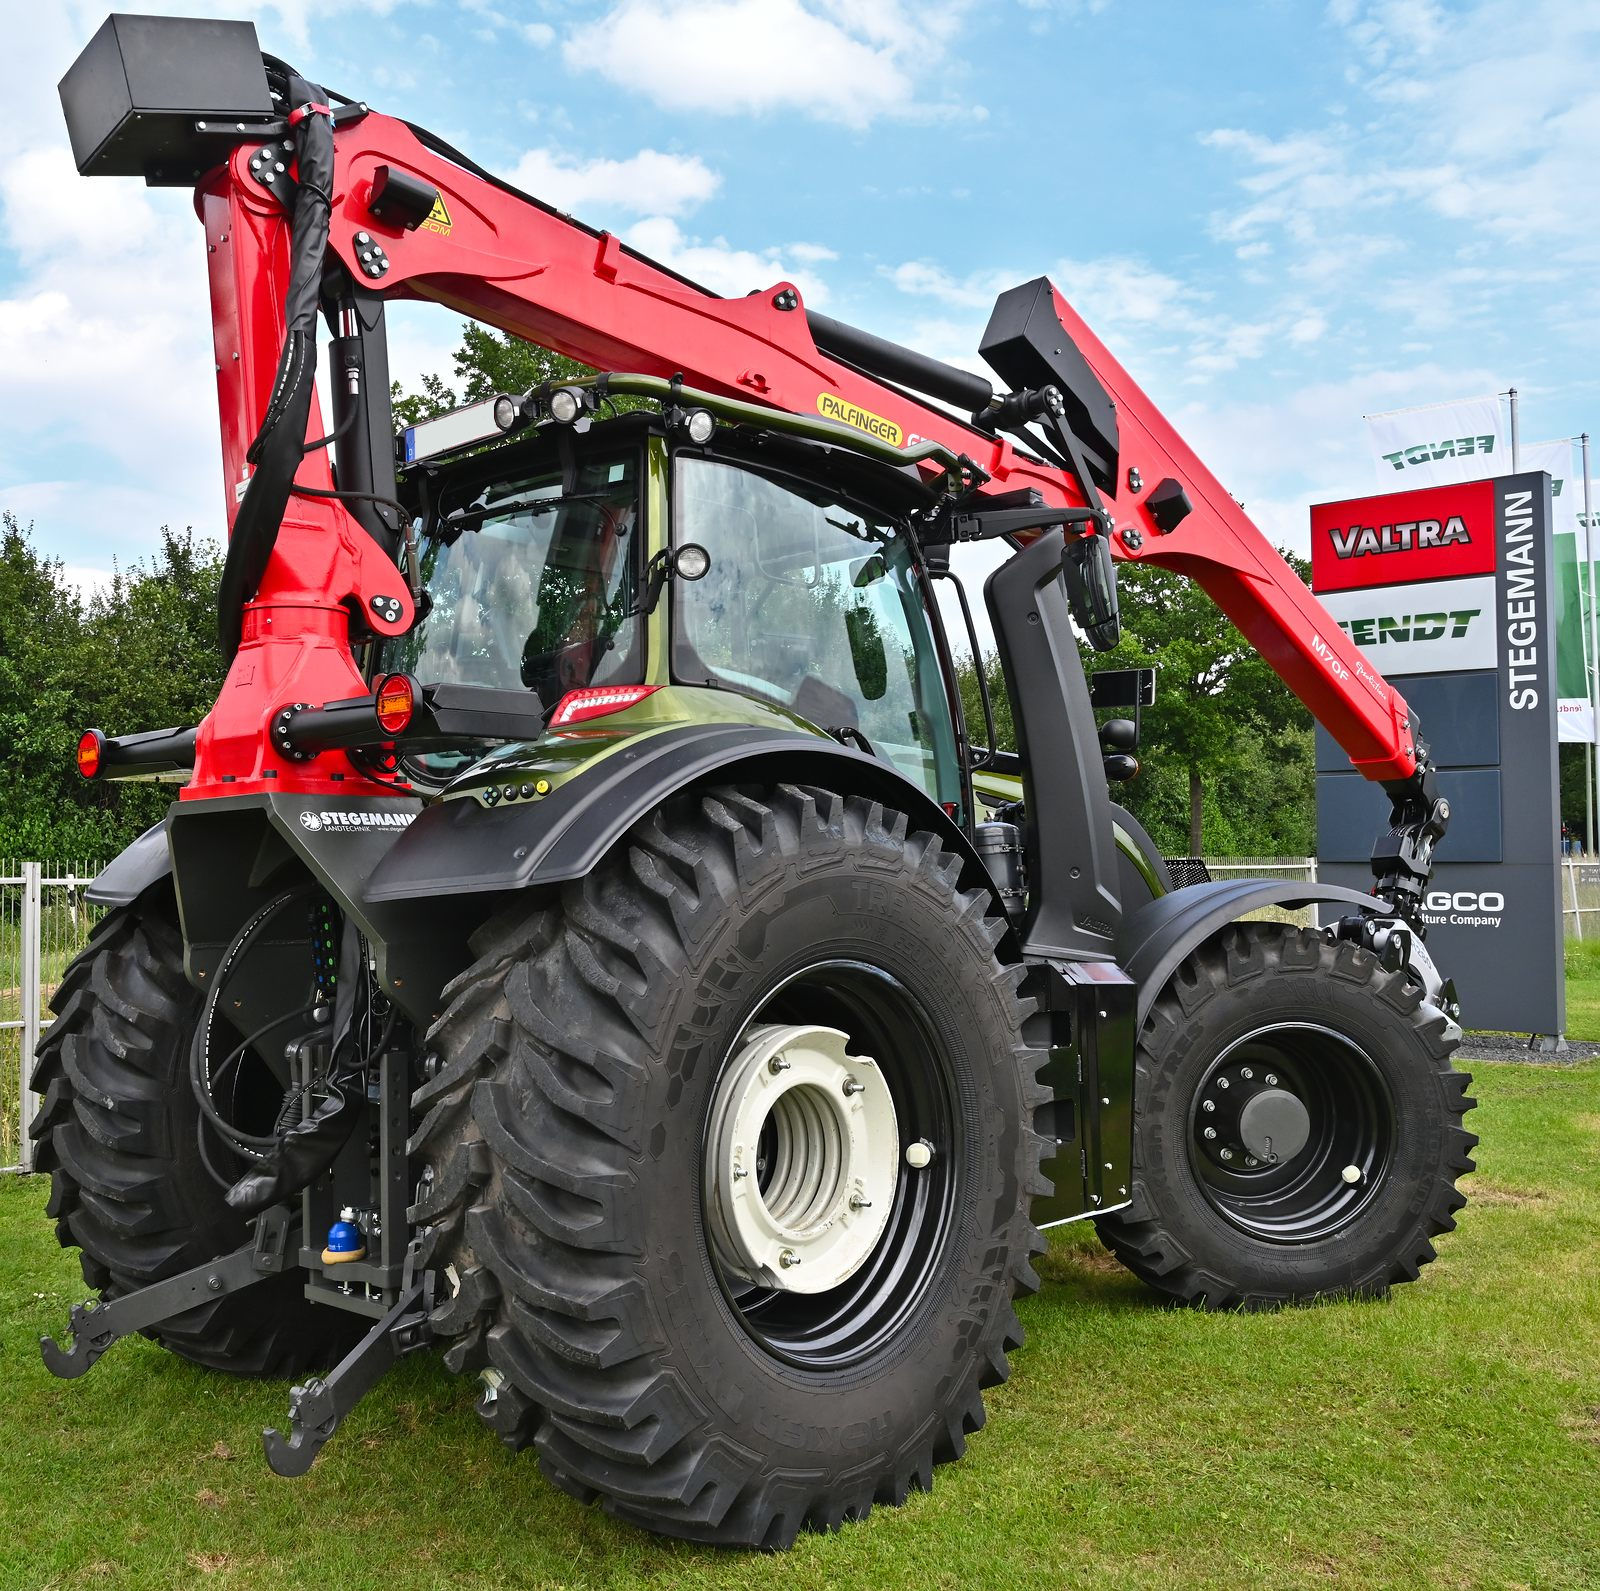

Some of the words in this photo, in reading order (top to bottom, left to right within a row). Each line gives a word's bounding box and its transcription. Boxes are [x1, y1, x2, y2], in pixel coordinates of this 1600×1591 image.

[821, 396, 898, 443] PALFINGER
[1328, 515, 1473, 560] VALTRA
[1504, 490, 1539, 710] STEGEMANN
[1311, 634, 1349, 681] M70F
[1449, 914, 1502, 928] Company
